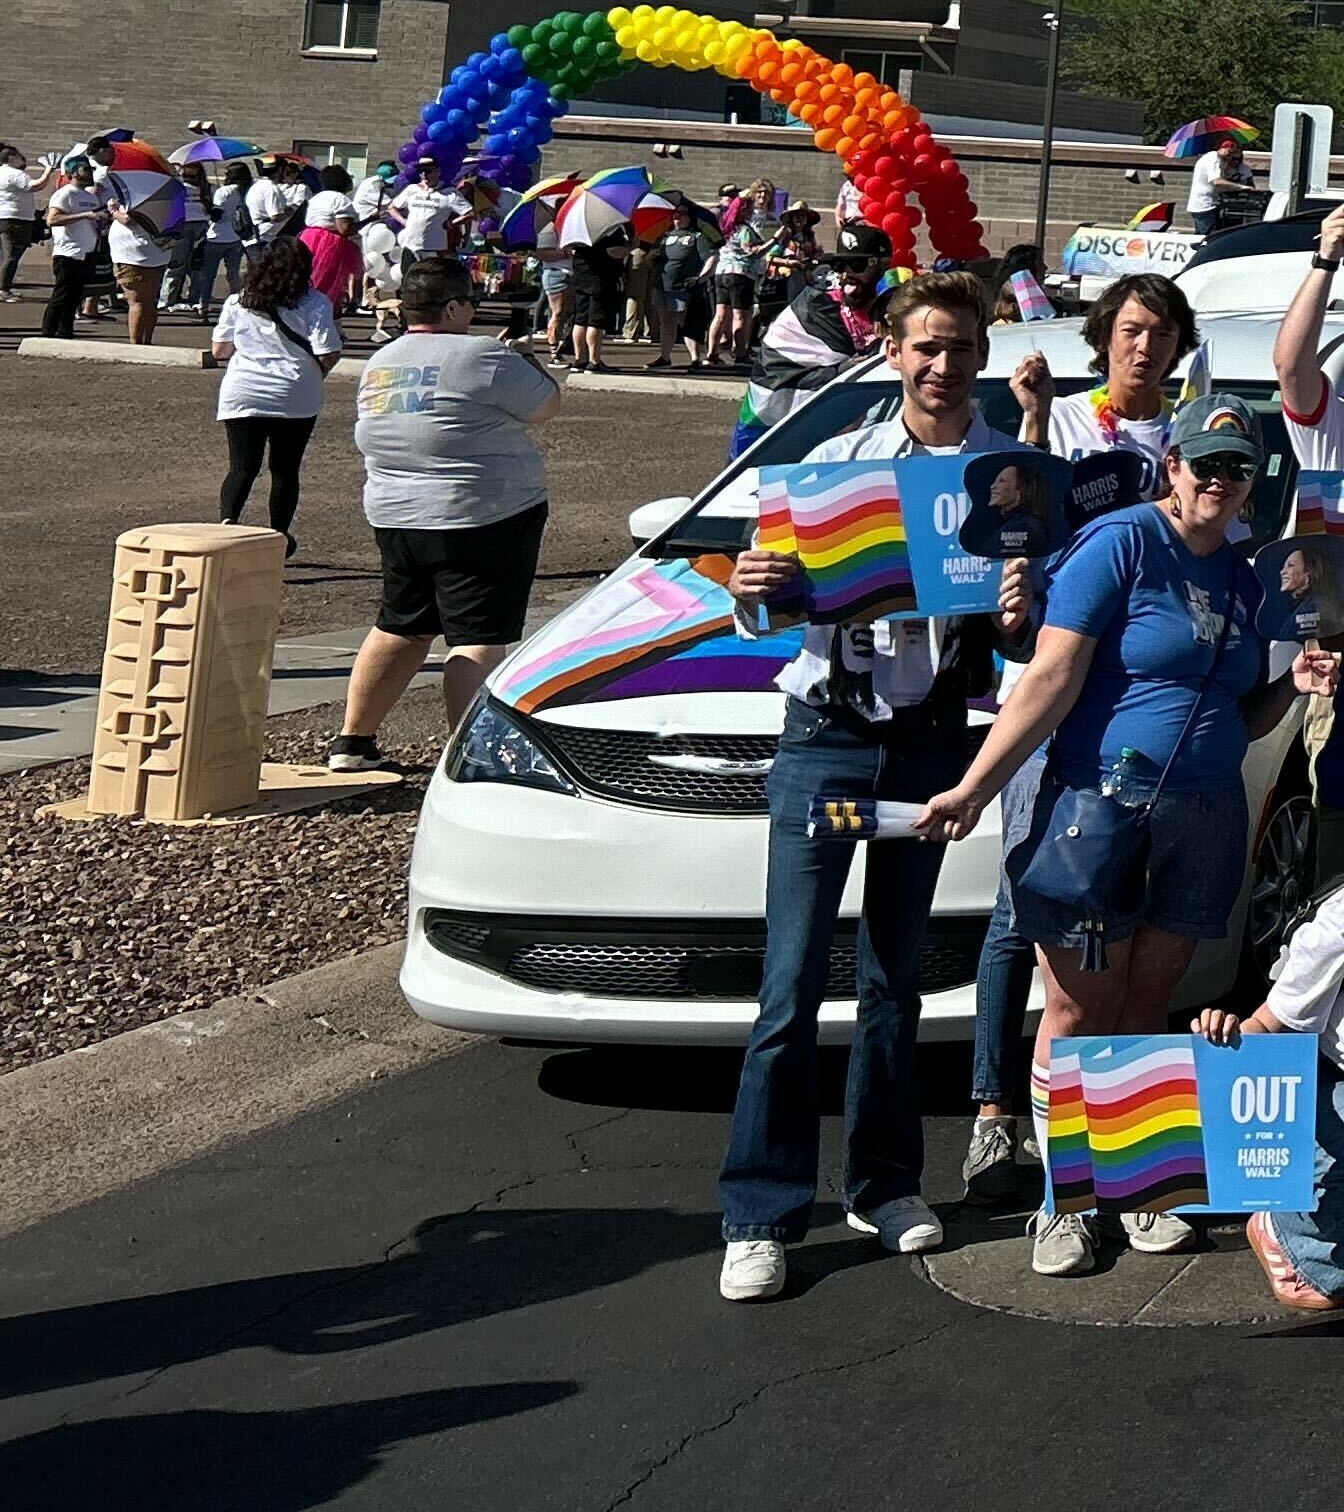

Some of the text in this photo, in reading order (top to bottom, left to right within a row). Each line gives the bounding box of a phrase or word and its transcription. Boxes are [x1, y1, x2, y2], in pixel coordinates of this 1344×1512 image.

[1072, 473, 1119, 505] HARRIS
[1083, 491, 1116, 512] WALZ
[943, 557, 992, 575] HARRIS
[950, 572, 985, 585] WALZ
[1231, 1076, 1302, 1123] OUT
[1255, 1131, 1273, 1139] FOR
[1237, 1147, 1290, 1167] HARRIS
[1245, 1166, 1281, 1178] WALZ
